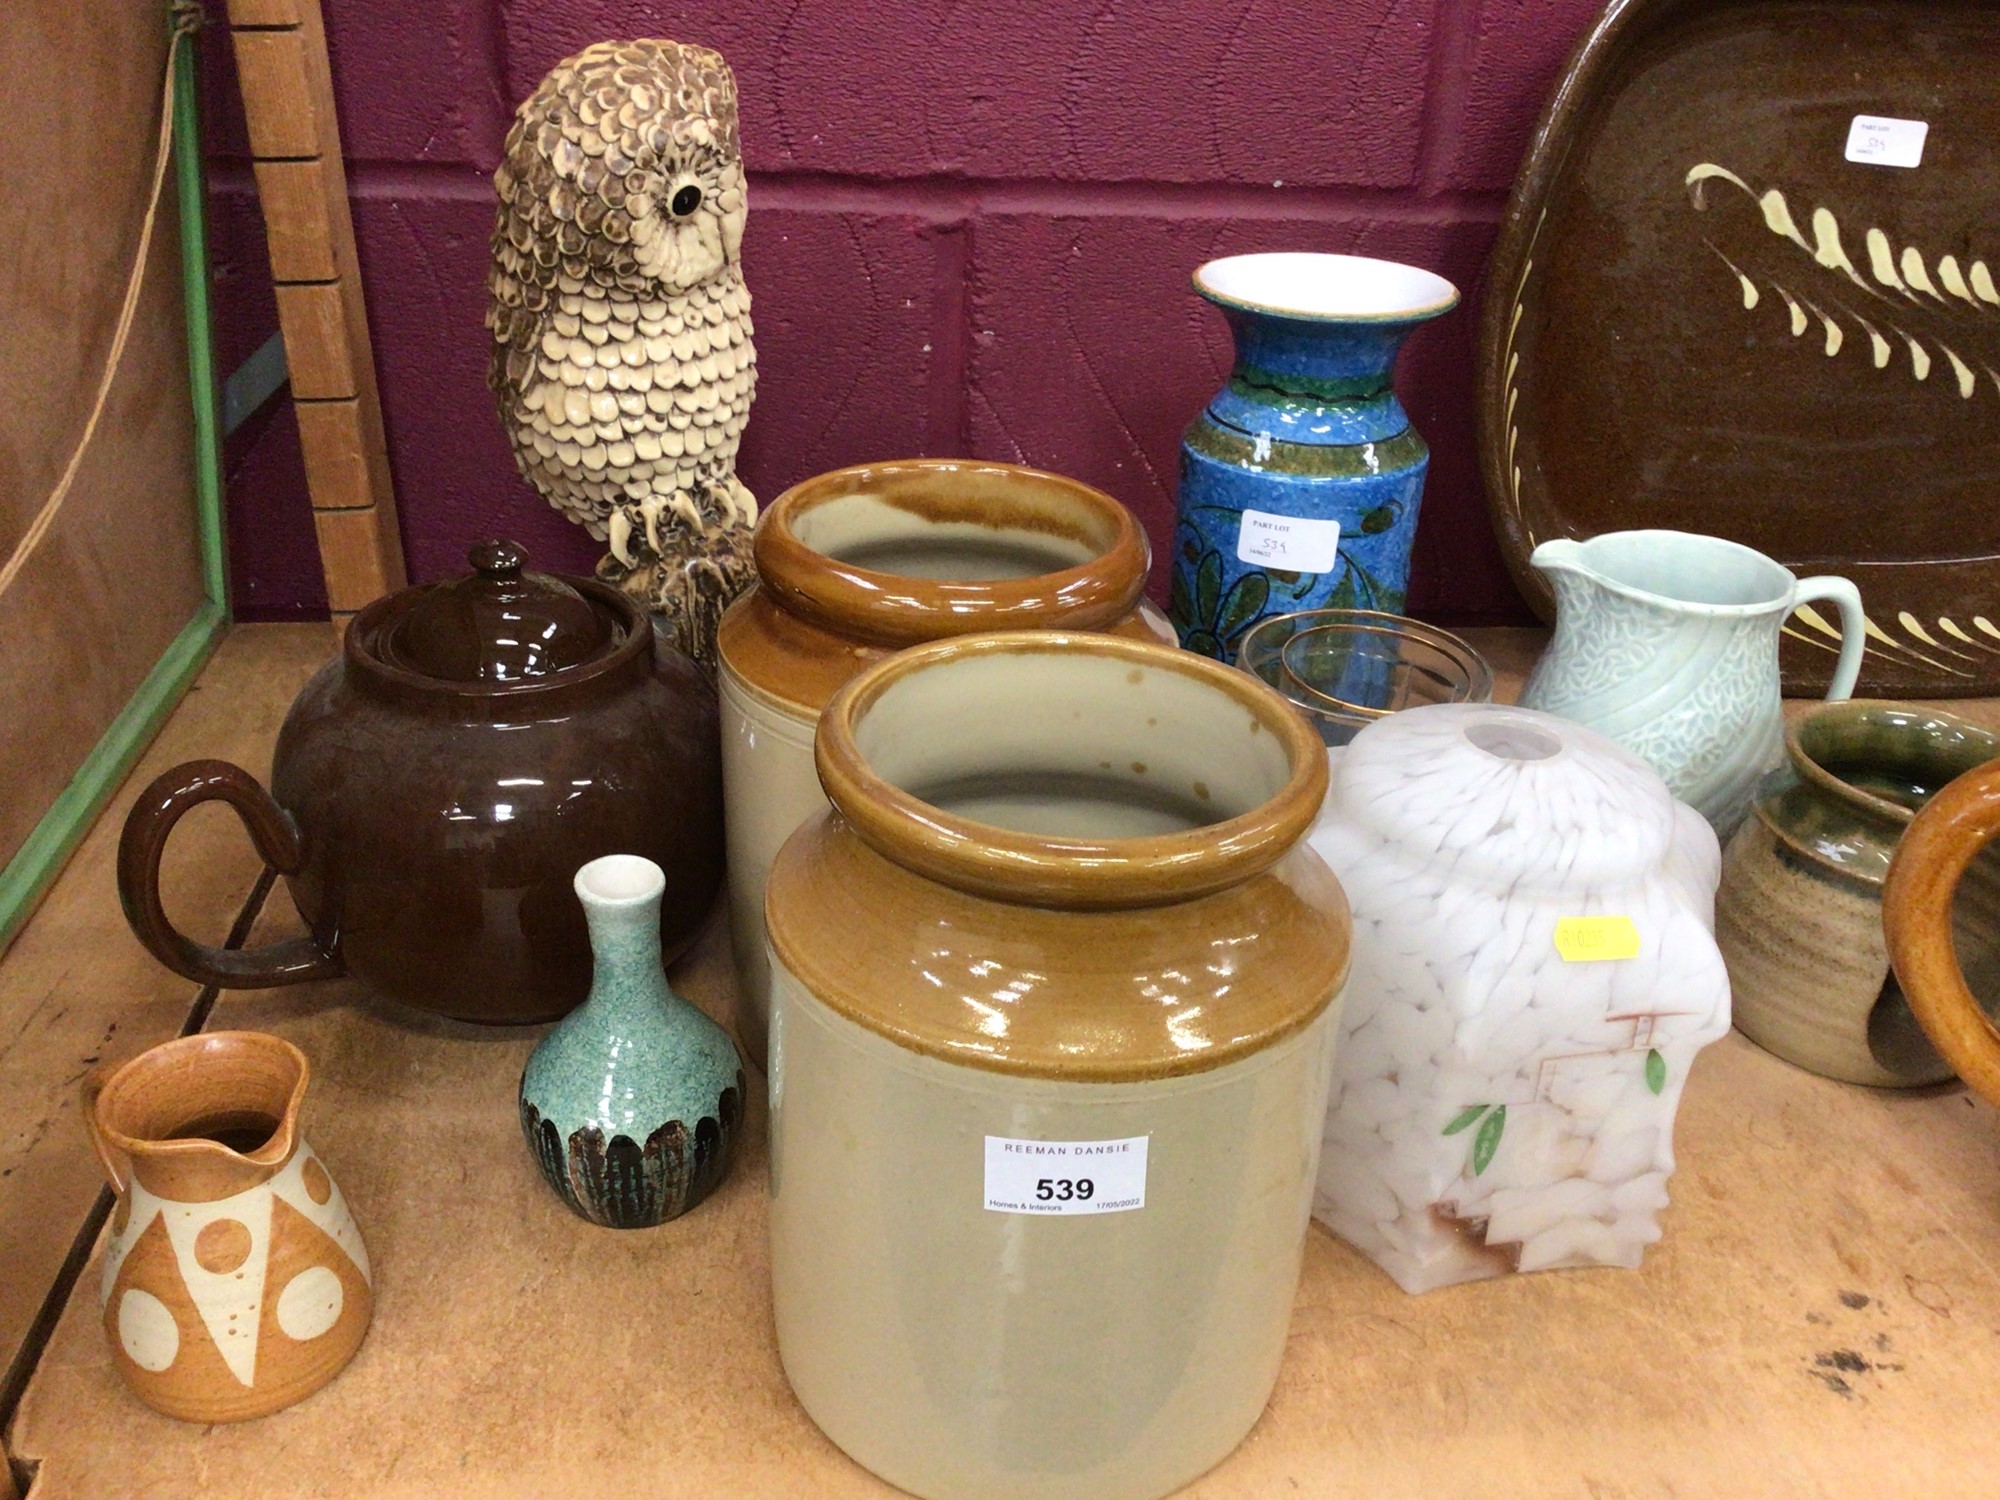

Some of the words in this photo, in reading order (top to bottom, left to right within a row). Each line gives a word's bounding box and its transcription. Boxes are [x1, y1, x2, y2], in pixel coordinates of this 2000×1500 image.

[1252, 520, 1272, 530] PART
[1274, 525, 1290, 533] LOT
[1004, 1143, 1067, 1156] REEMAN
[1074, 1143, 1131, 1156] DANSIE
[1035, 1178, 1095, 1202] 539
[989, 1199, 1019, 1210] Homes
[1020, 1203, 1027, 1211] &
[1029, 1203, 1063, 1212] Interiors
[1096, 1198, 1140, 1210] 17/05/2022
